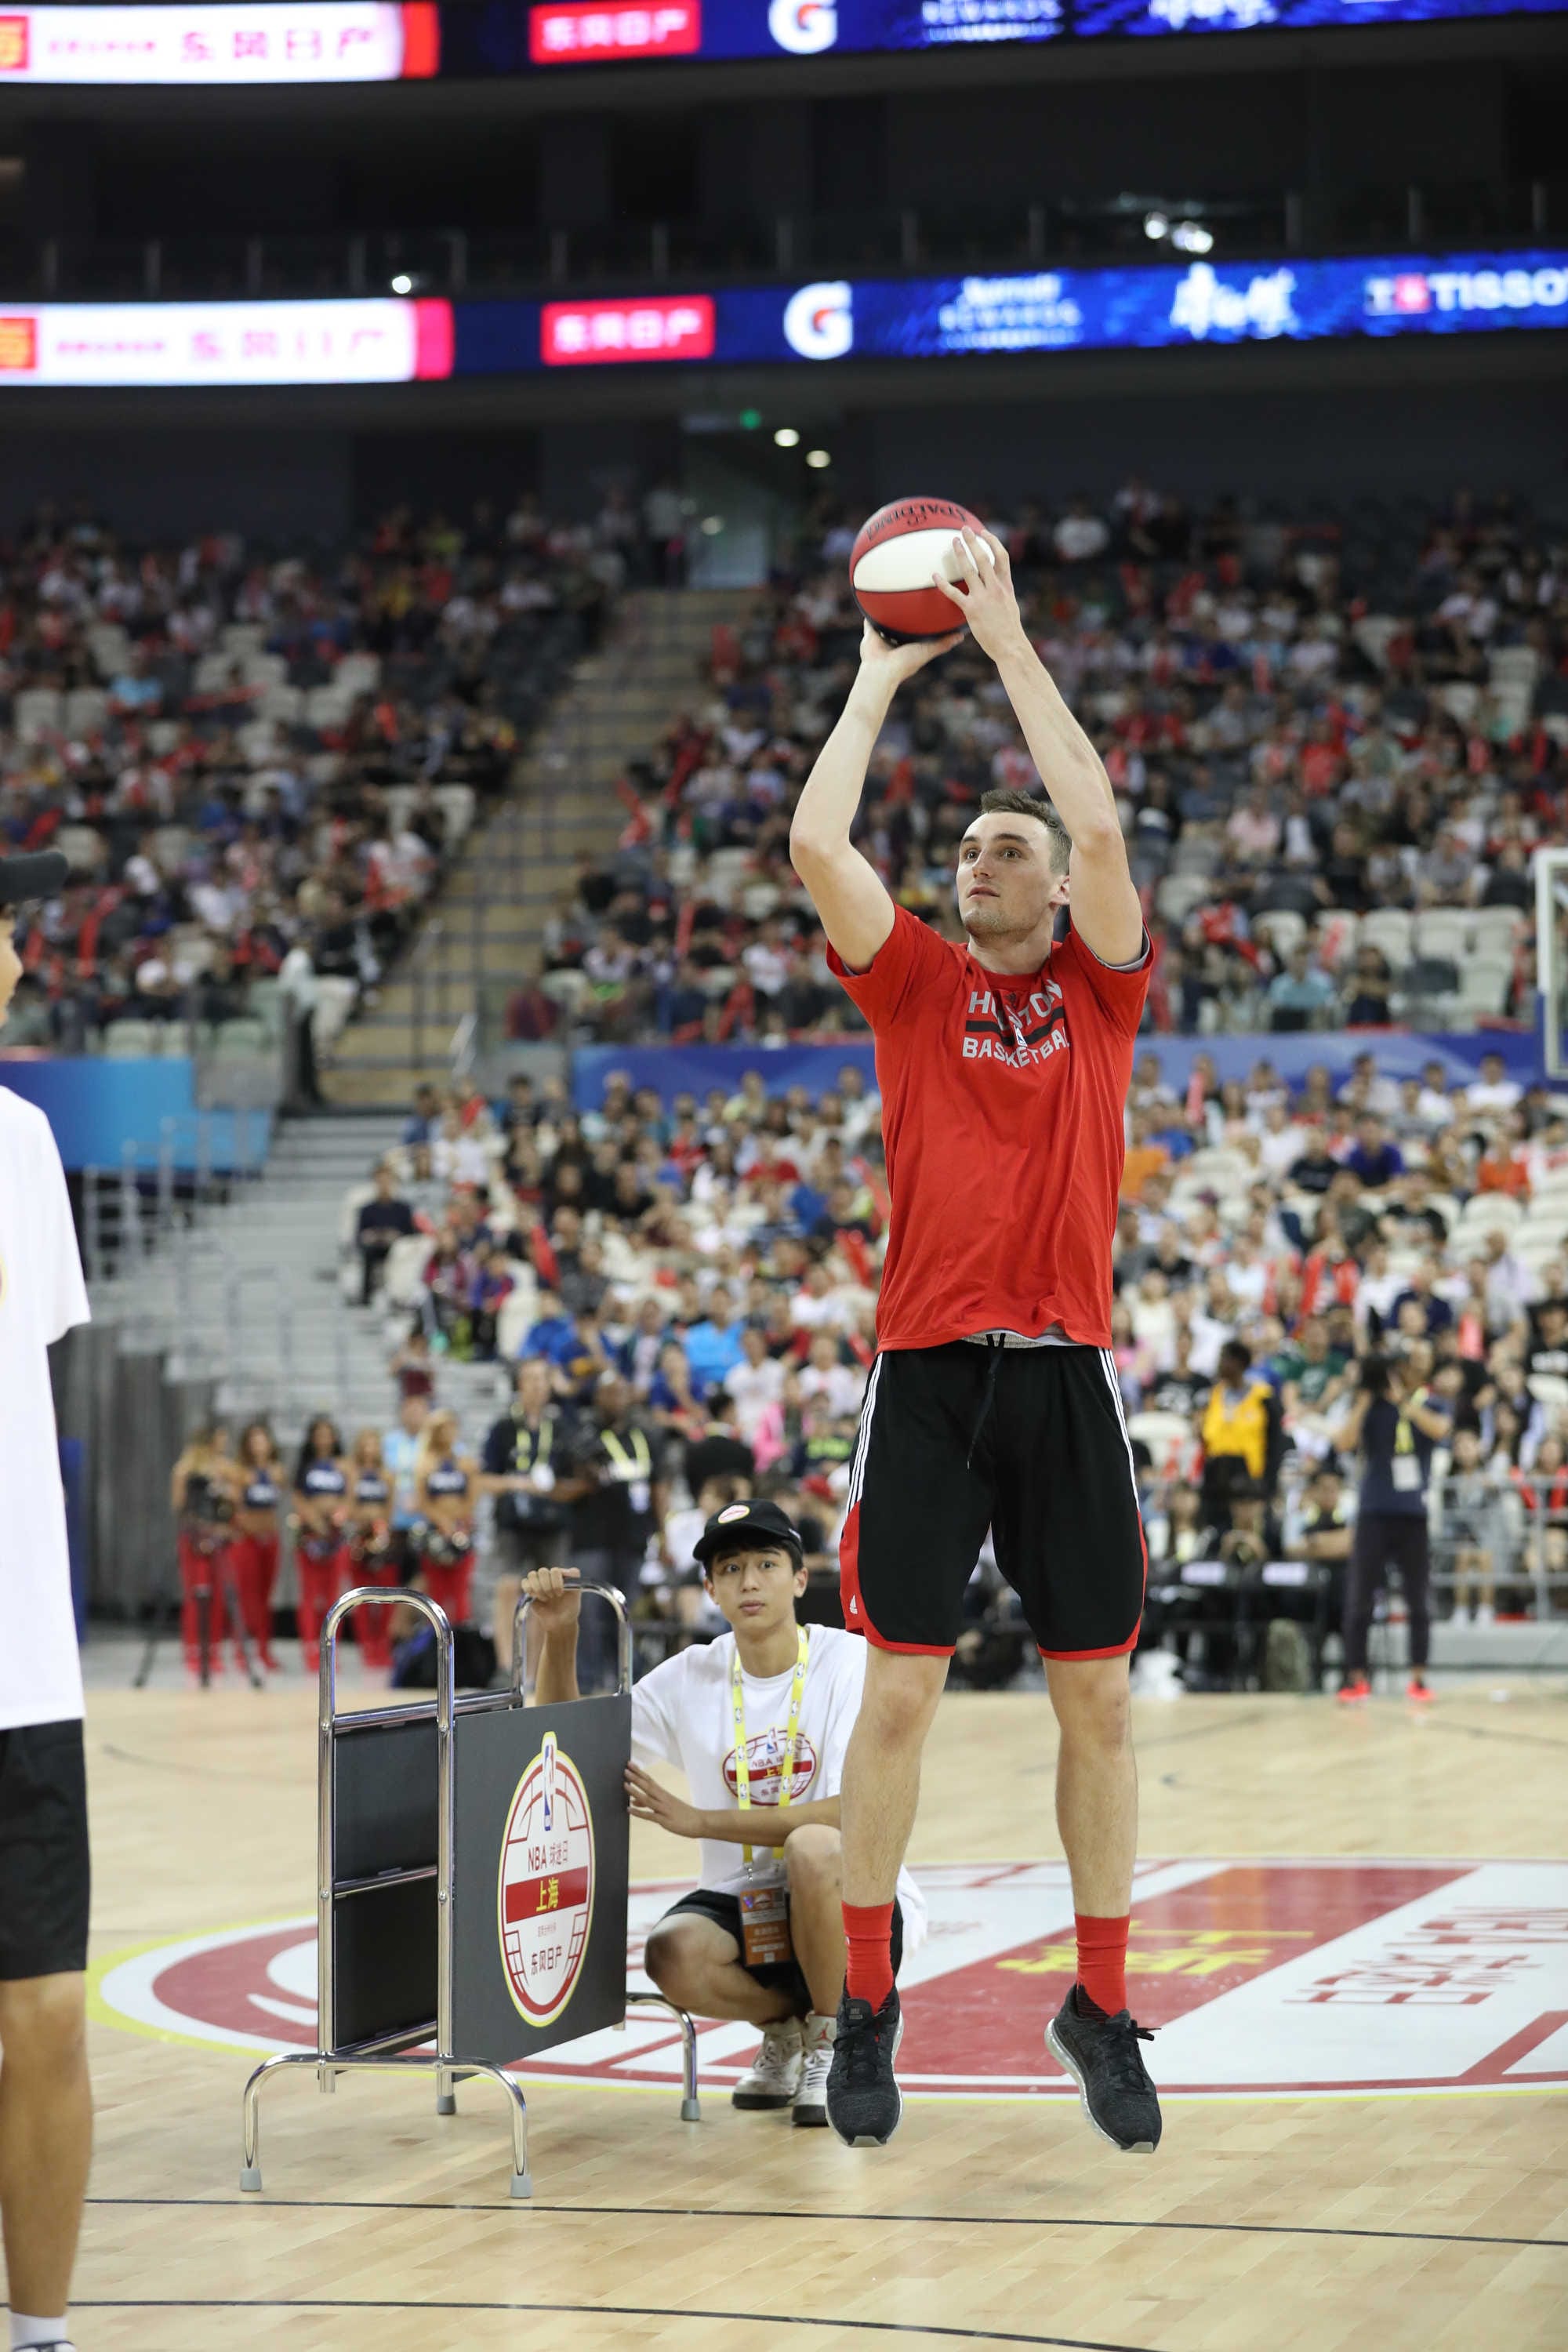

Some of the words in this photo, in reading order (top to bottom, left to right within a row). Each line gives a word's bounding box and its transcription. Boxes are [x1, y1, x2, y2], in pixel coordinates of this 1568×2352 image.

[1428, 267, 1568, 311] TISSO
[784, 280, 853, 361] G
[528, 1844, 547, 1873] NBA
[536, 1877, 559, 1912] 上海
[531, 1946, 562, 1976] 东风日产
